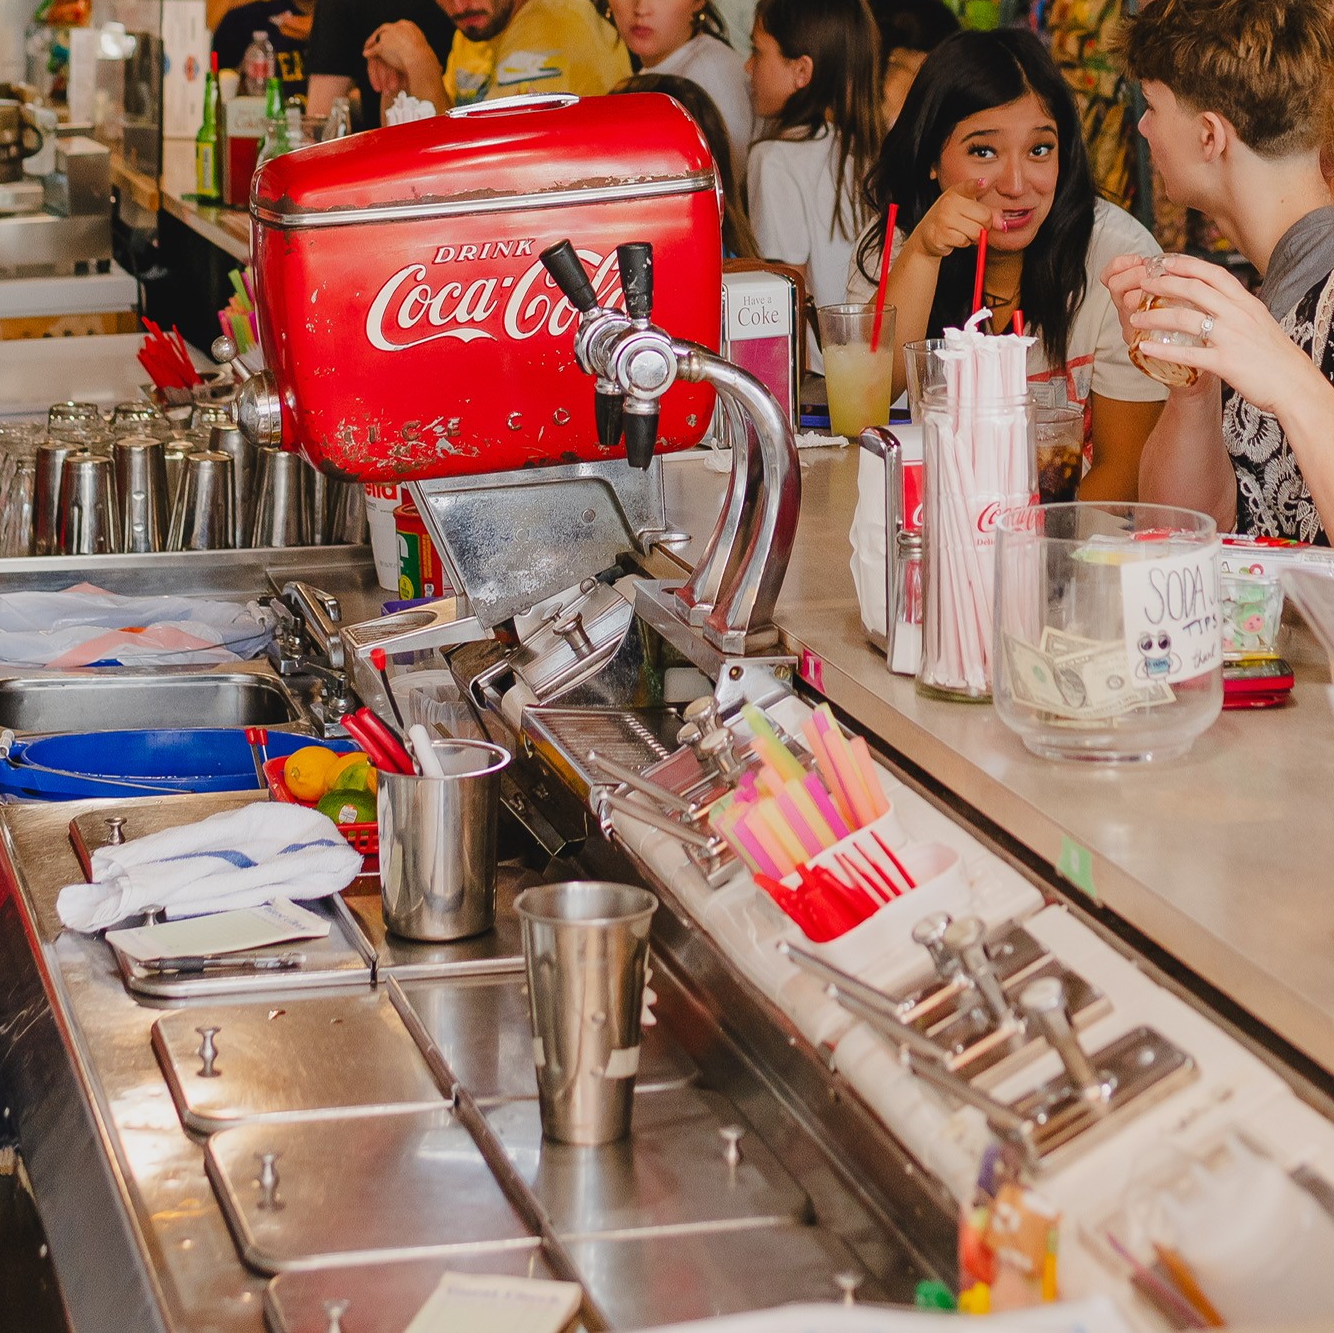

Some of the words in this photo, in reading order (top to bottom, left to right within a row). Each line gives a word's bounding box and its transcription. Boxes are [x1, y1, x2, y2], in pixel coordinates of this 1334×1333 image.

[433, 238, 536, 265] DRINK
[743, 296, 766, 306] Have
[767, 296, 773, 304] a
[738, 306, 780, 327] Coke
[1144, 564, 1207, 625] SODA
[1182, 613, 1219, 636] TIPS
